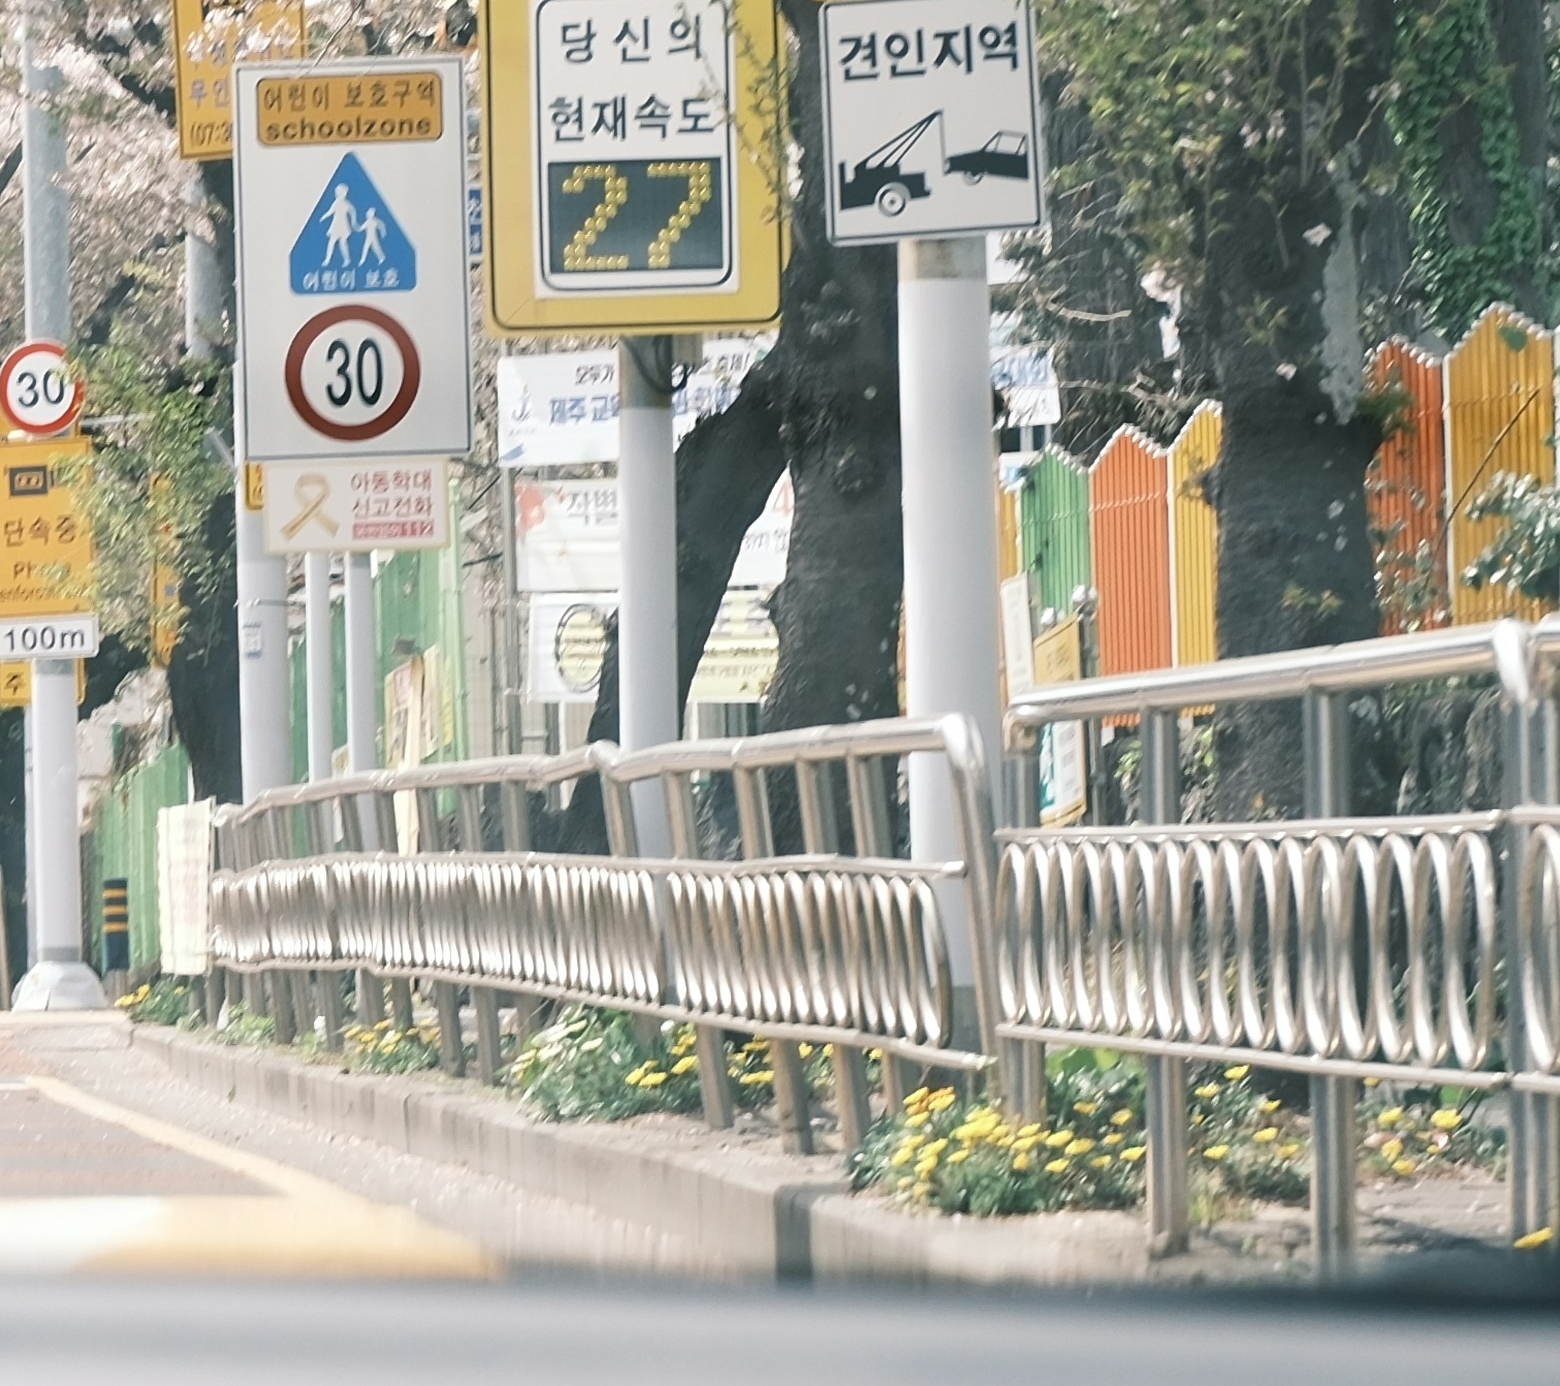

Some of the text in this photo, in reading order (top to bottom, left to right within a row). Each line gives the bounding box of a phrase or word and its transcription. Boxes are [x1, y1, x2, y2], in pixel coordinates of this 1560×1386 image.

[562, 13, 705, 65] 당신의
[838, 20, 1018, 81] 견인지역
[264, 79, 436, 112] 어린이 보호구역
[548, 93, 718, 143] 현재속도
[266, 116, 433, 141] schoolzone
[562, 161, 713, 272] 27
[15, 368, 66, 411] 30
[325, 337, 383, 407] 30
[3, 515, 77, 548] 단속중
[4, 625, 85, 652] 100m
